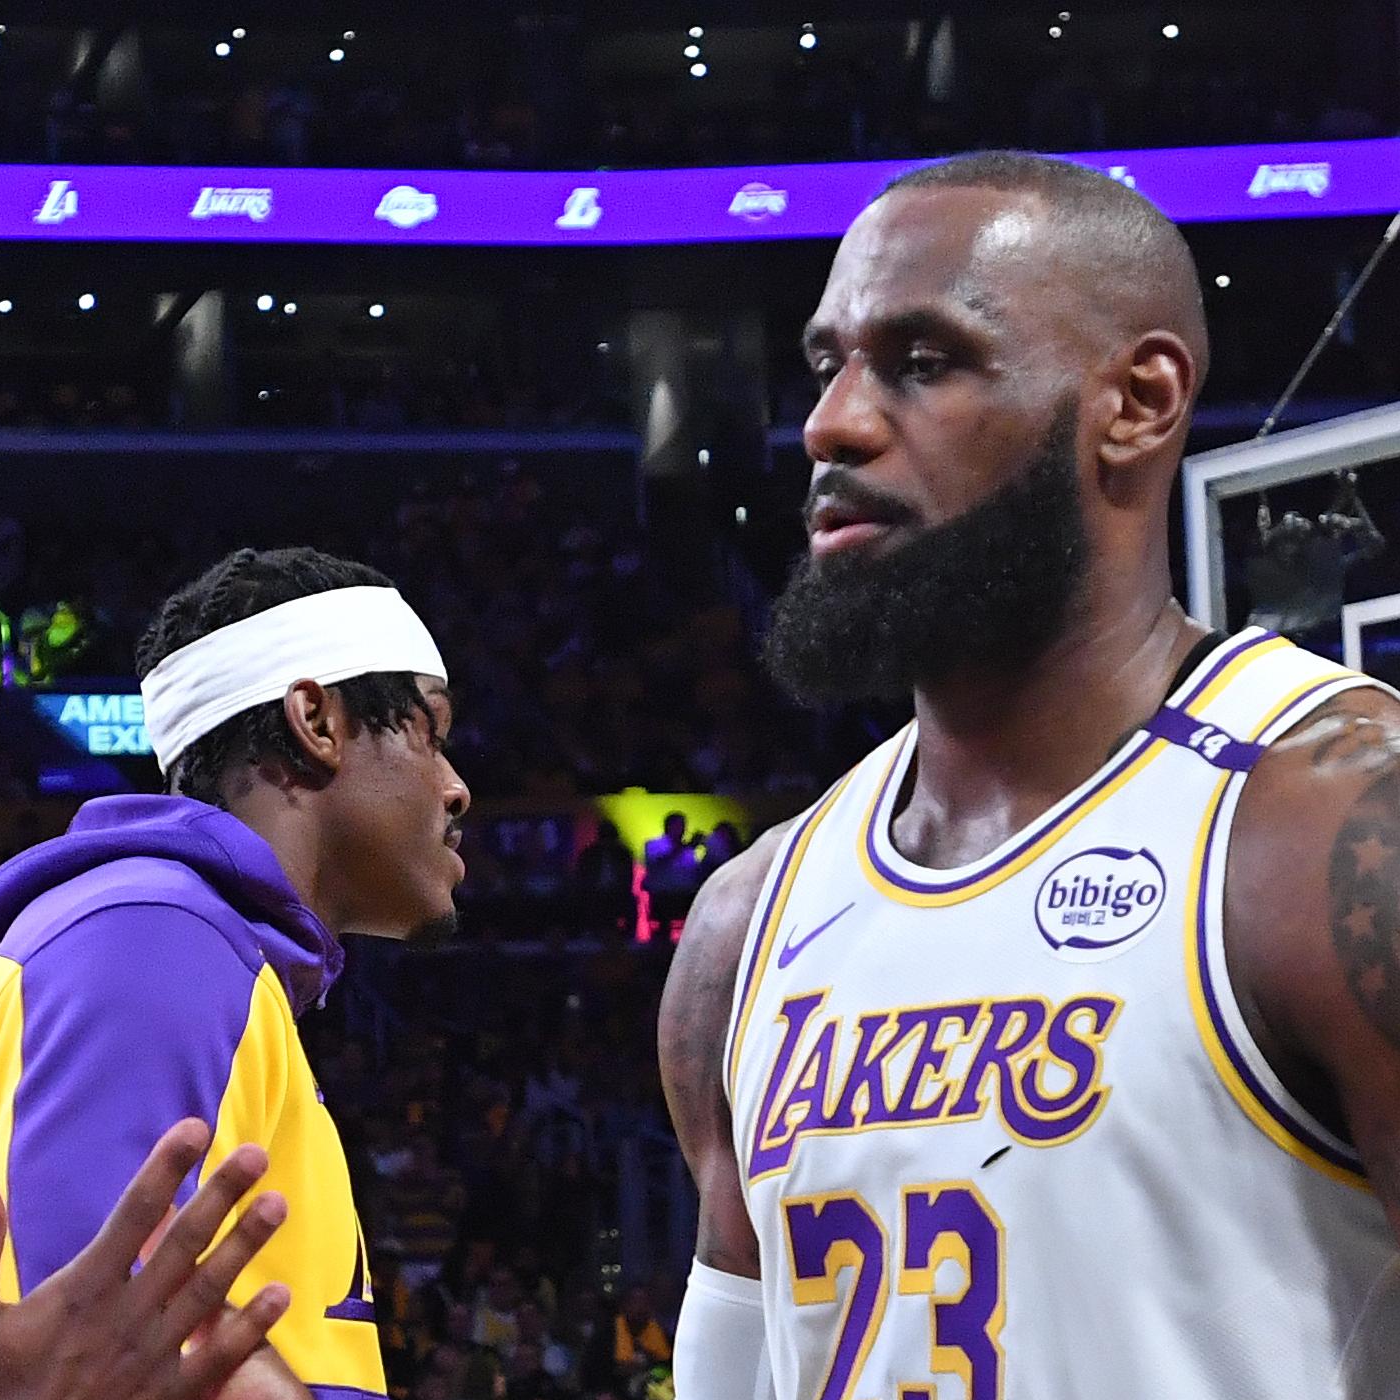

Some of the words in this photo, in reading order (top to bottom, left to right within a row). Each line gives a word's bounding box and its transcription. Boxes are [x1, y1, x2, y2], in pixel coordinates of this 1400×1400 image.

[1188, 717, 1231, 760] 44
[1047, 874, 1157, 917] bibigo
[1061, 909, 1106, 926] 비비고
[749, 985, 1125, 1184] LAKERS
